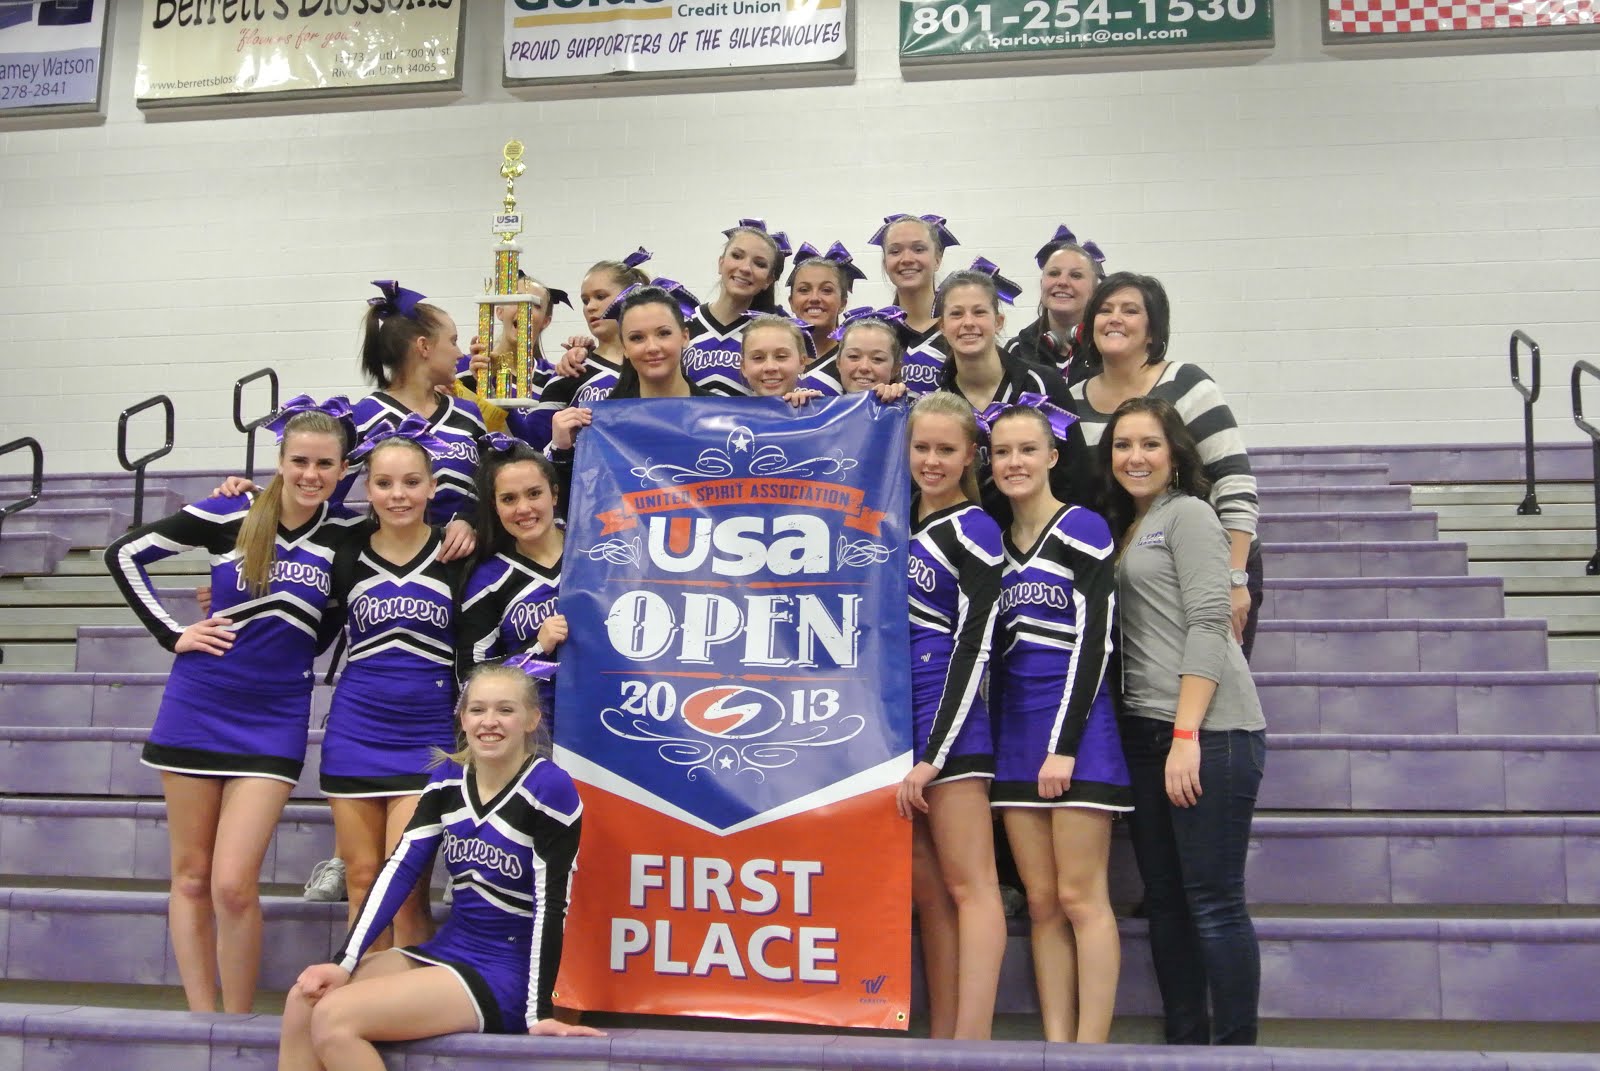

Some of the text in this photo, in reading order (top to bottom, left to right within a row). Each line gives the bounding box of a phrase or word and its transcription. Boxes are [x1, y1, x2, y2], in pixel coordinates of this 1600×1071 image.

[677, 4, 728, 17] Credit
[733, 1, 780, 15] Union
[913, 0, 1256, 35] 801-254-1530
[295, 25, 320, 49] for
[510, 21, 841, 61] PROUD SUPPORTERS OF THE SILVERWOLVES
[989, 28, 1188, 47] barlowsinc@aol.com
[43, 57, 94, 77] Watson
[379, 65, 403, 76] Utah
[634, 482, 850, 510] UNITED SPIRIT ASSOCIATION
[353, 594, 448, 632] Pioneers
[604, 590, 863, 669] OPEN
[620, 681, 839, 726] 20 13
[629, 854, 824, 916] FIRST
[610, 917, 839, 985] PLACE
